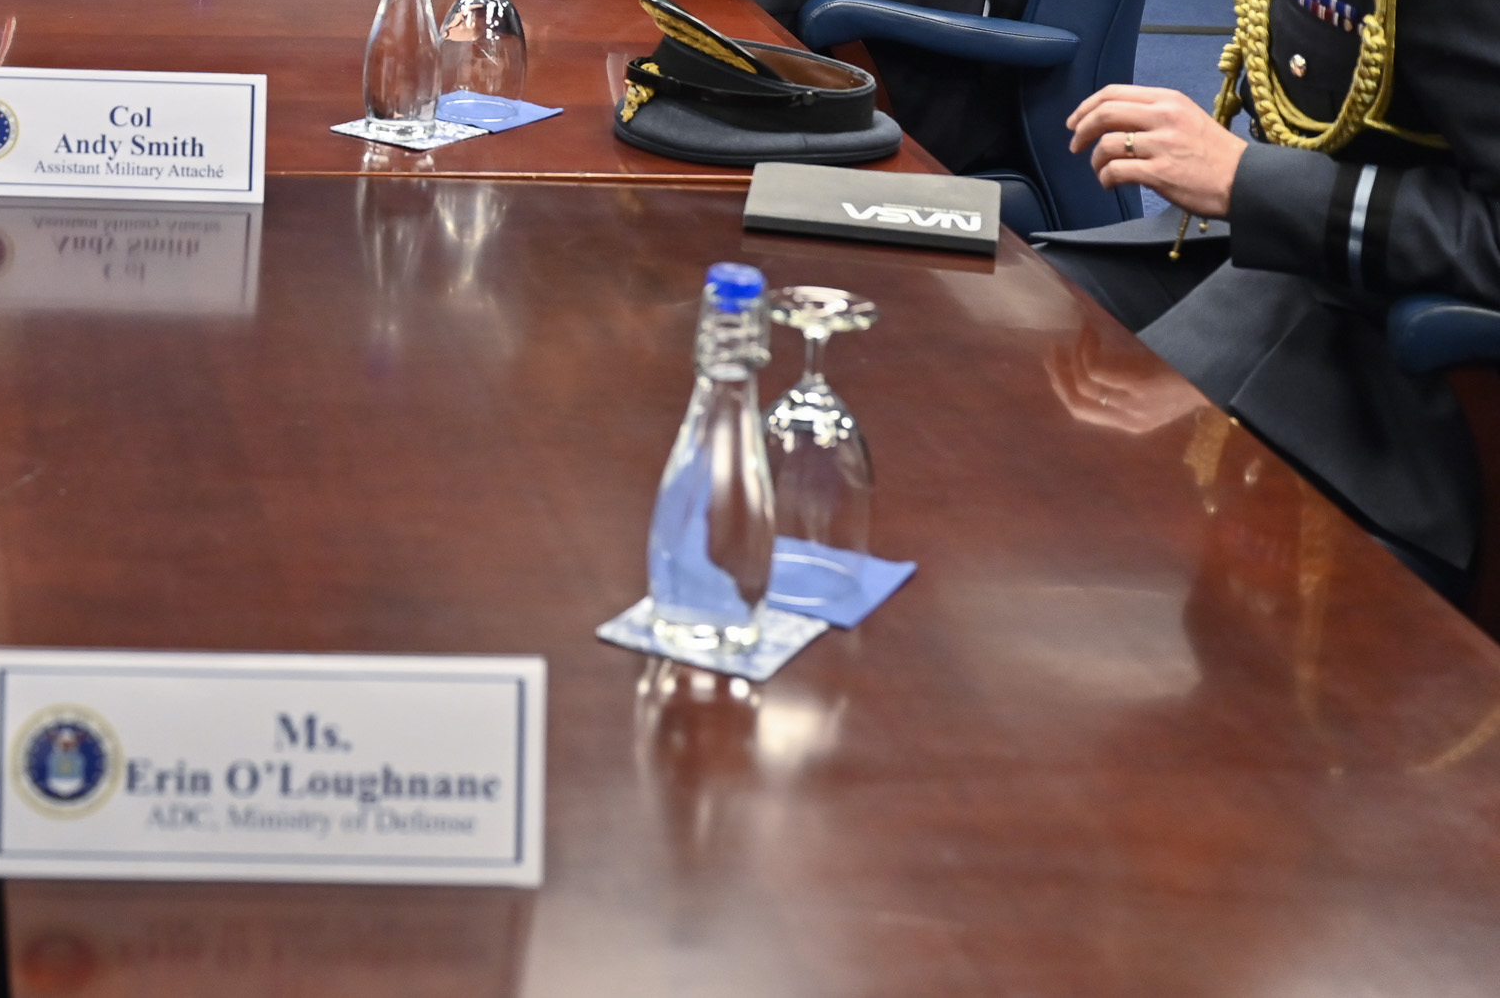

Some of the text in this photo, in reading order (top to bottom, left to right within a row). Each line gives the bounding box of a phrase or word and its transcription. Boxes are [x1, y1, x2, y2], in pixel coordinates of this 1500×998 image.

[109, 105, 152, 128] Col
[54, 133, 205, 160] Andy Smith
[34, 159, 224, 180] Assistant Military Attaché
[841, 202, 982, 232] NASA
[275, 713, 352, 752] Ms.
[124, 760, 212, 796] Erin
